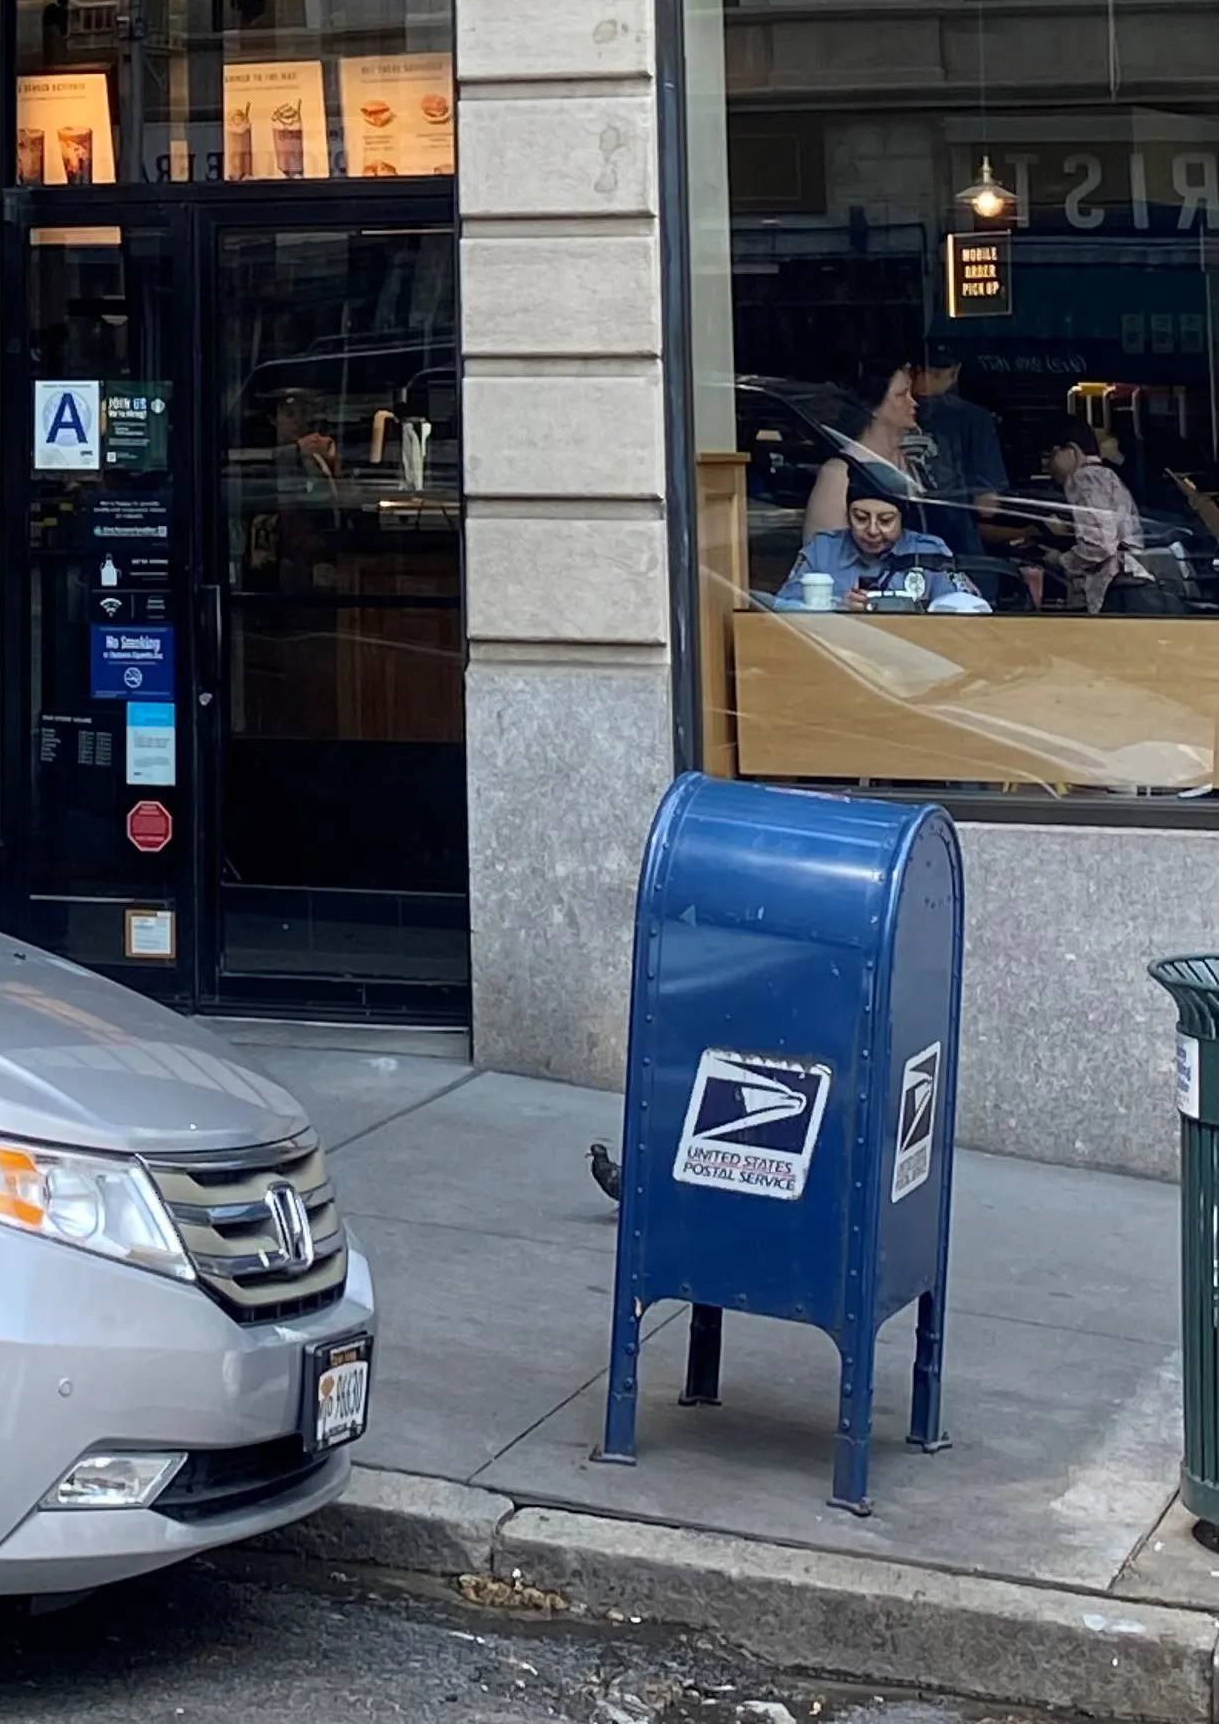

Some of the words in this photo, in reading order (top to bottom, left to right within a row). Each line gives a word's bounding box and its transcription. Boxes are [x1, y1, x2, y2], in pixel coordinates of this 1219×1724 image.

[961, 246, 998, 262] MOBILE
[964, 264, 996, 279] ORDER
[962, 282, 985, 296] PICK
[985, 281, 1000, 295] UP
[107, 396, 131, 410] JOIN
[45, 392, 88, 444] A
[105, 635, 119, 650] No
[120, 635, 161, 653] Smoking
[687, 1145, 741, 1165] UNITED
[742, 1154, 794, 1174] STATES
[683, 1161, 736, 1181] POSTAL
[739, 1170, 795, 1191] SERVICE
